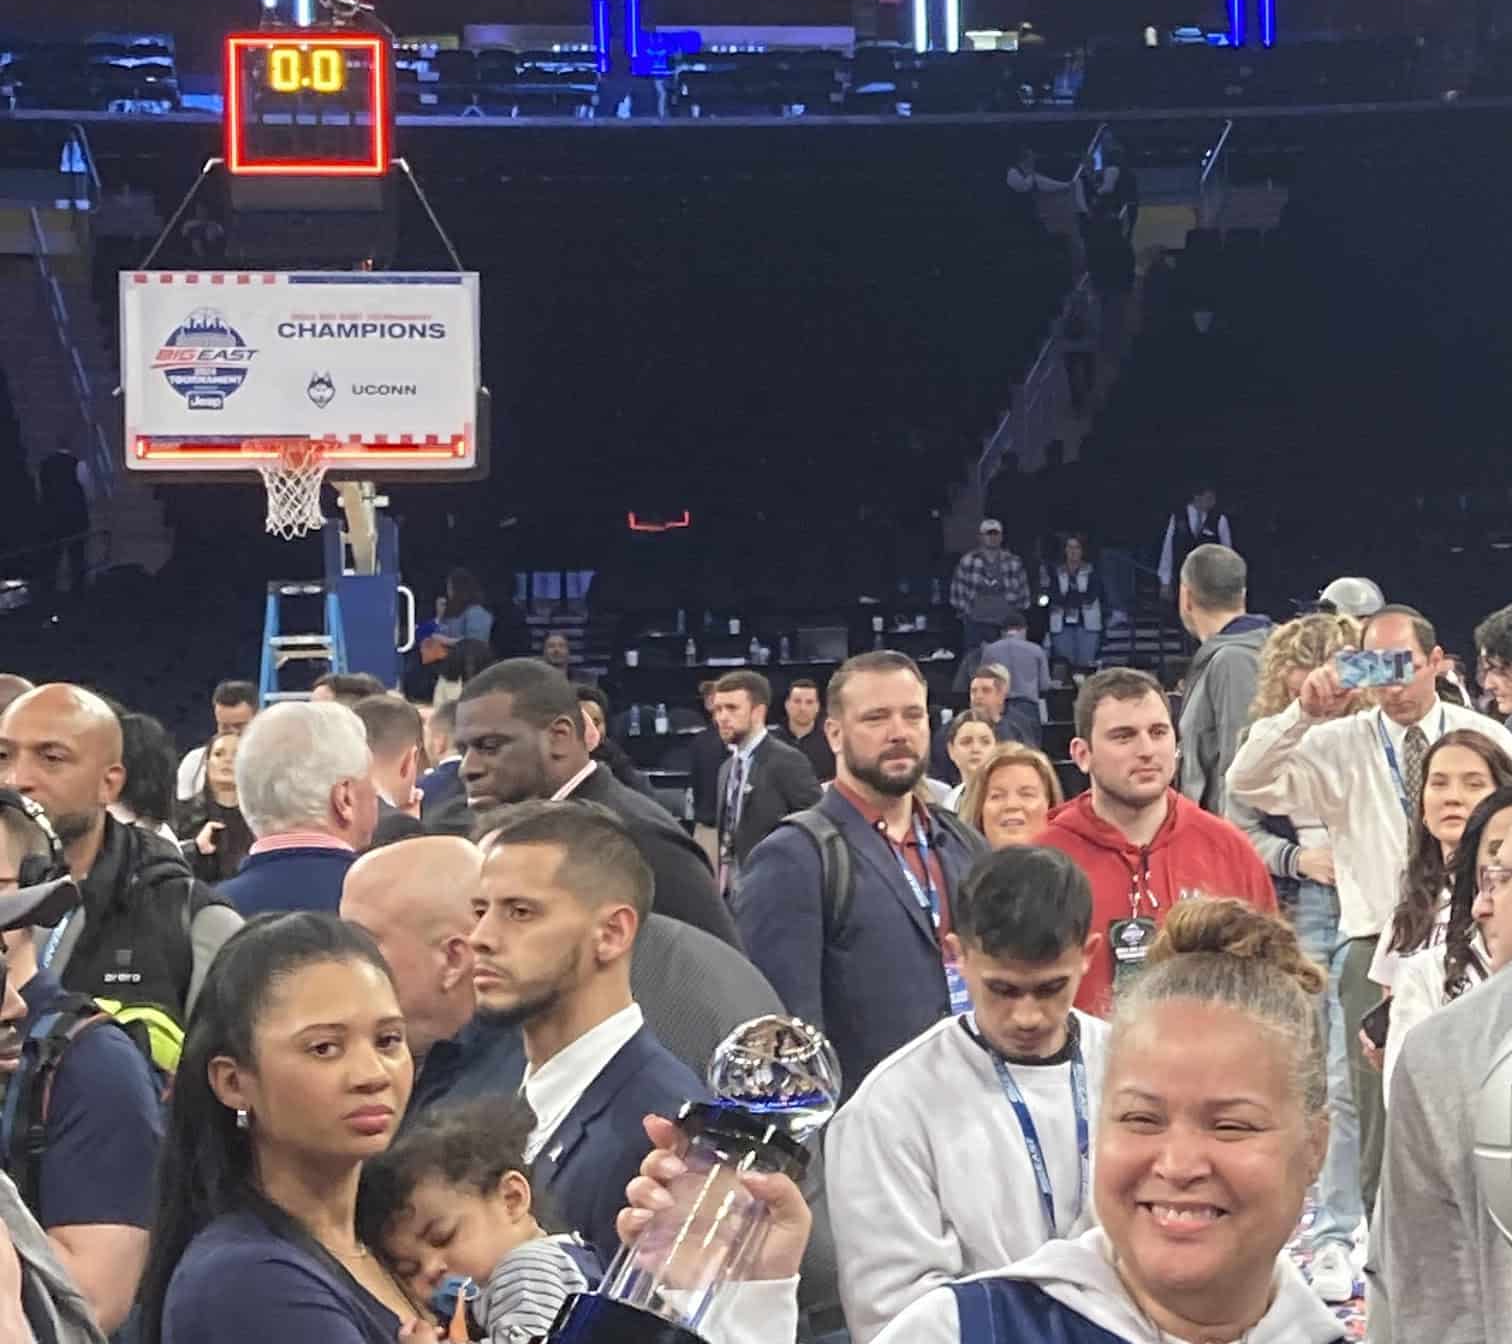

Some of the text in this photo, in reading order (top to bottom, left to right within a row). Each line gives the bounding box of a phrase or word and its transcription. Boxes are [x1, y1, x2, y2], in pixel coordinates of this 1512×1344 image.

[277, 321, 447, 340] CHAMPIONS
[155, 348, 260, 362] BIG EAST
[352, 384, 417, 396] UCONN
